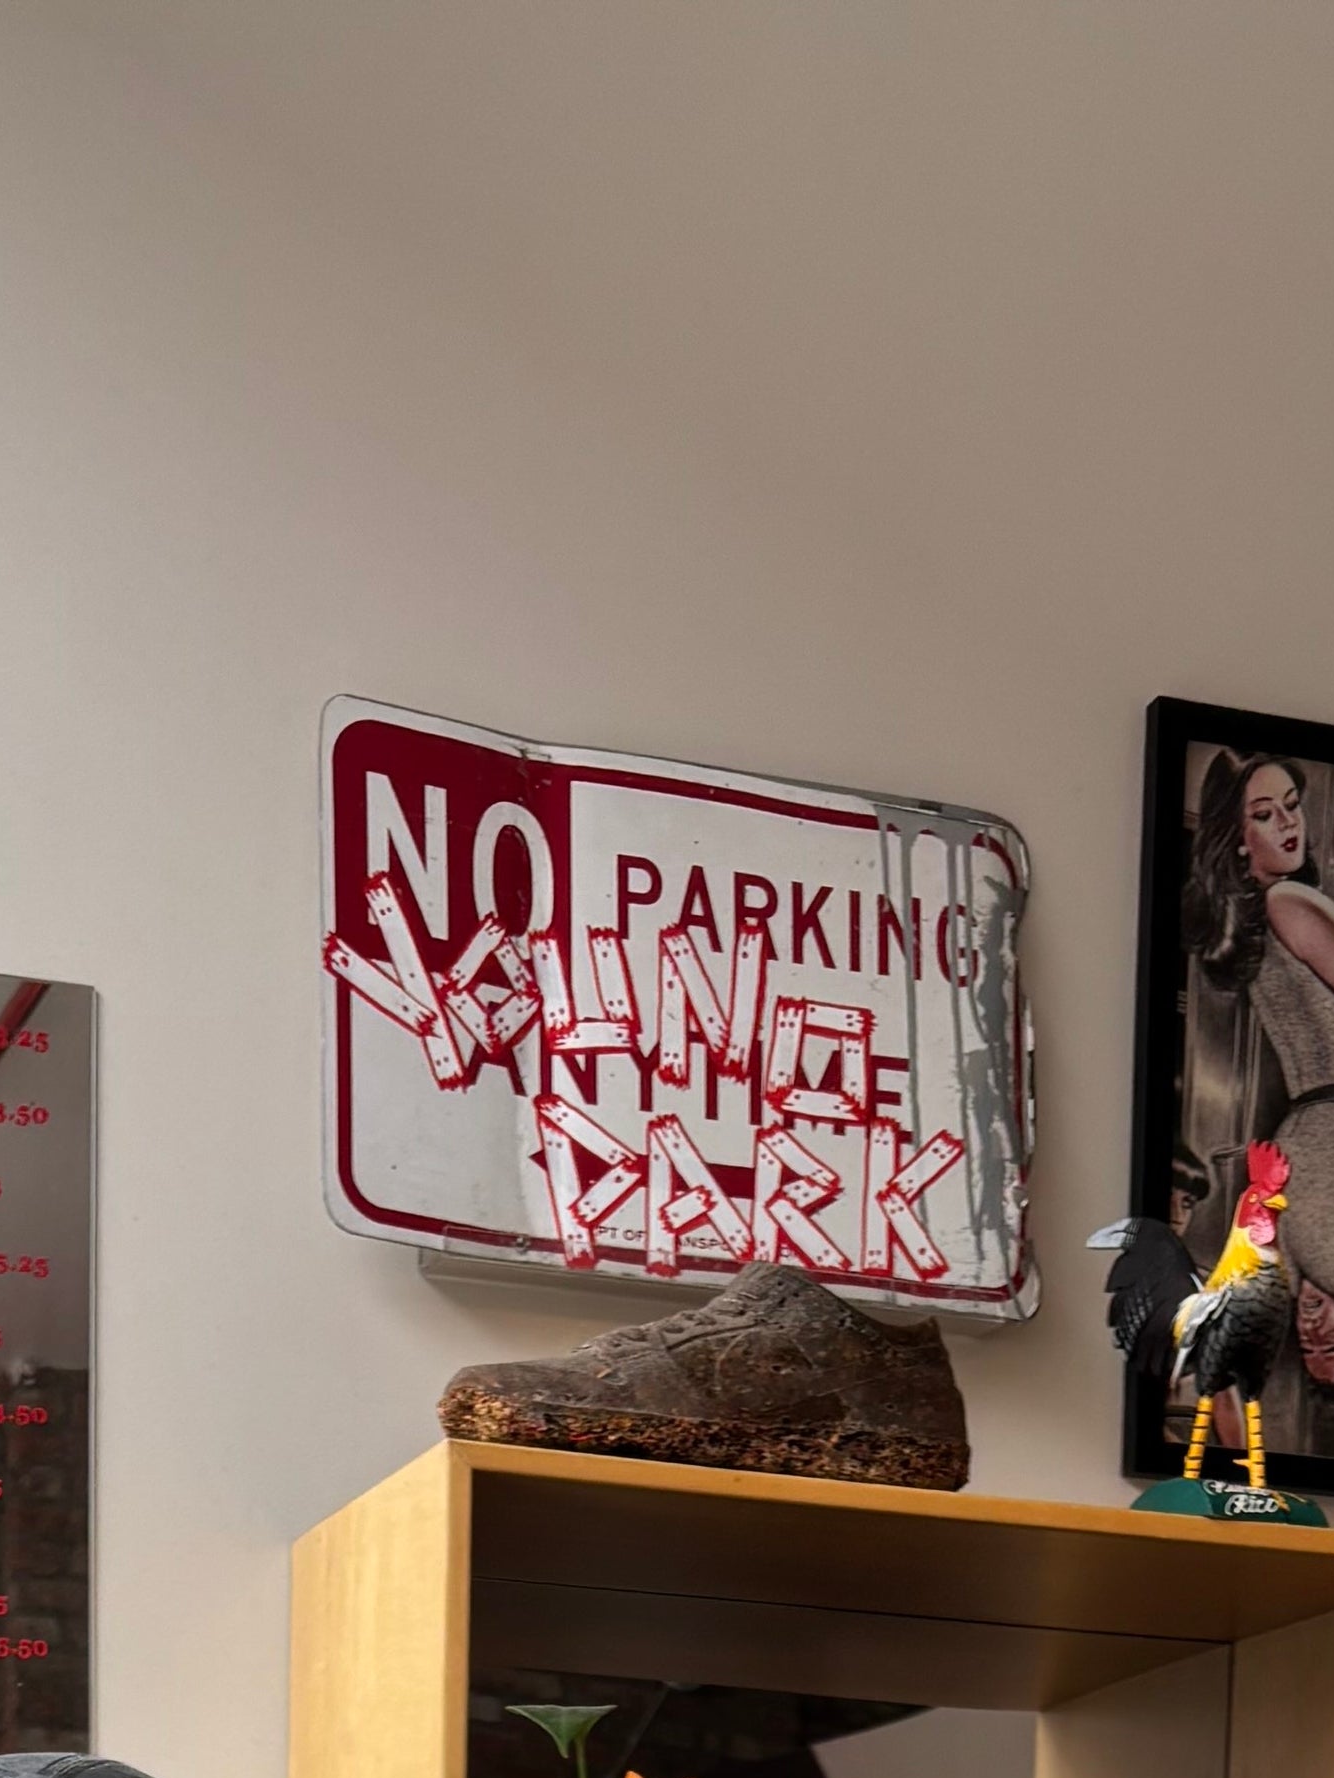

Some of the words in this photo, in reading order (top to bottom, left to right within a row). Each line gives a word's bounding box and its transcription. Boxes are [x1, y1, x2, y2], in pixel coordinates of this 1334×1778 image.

[364, 770, 555, 942] NO
[616, 853, 979, 987] PARKING
[535, 1095, 965, 1280] PARK
